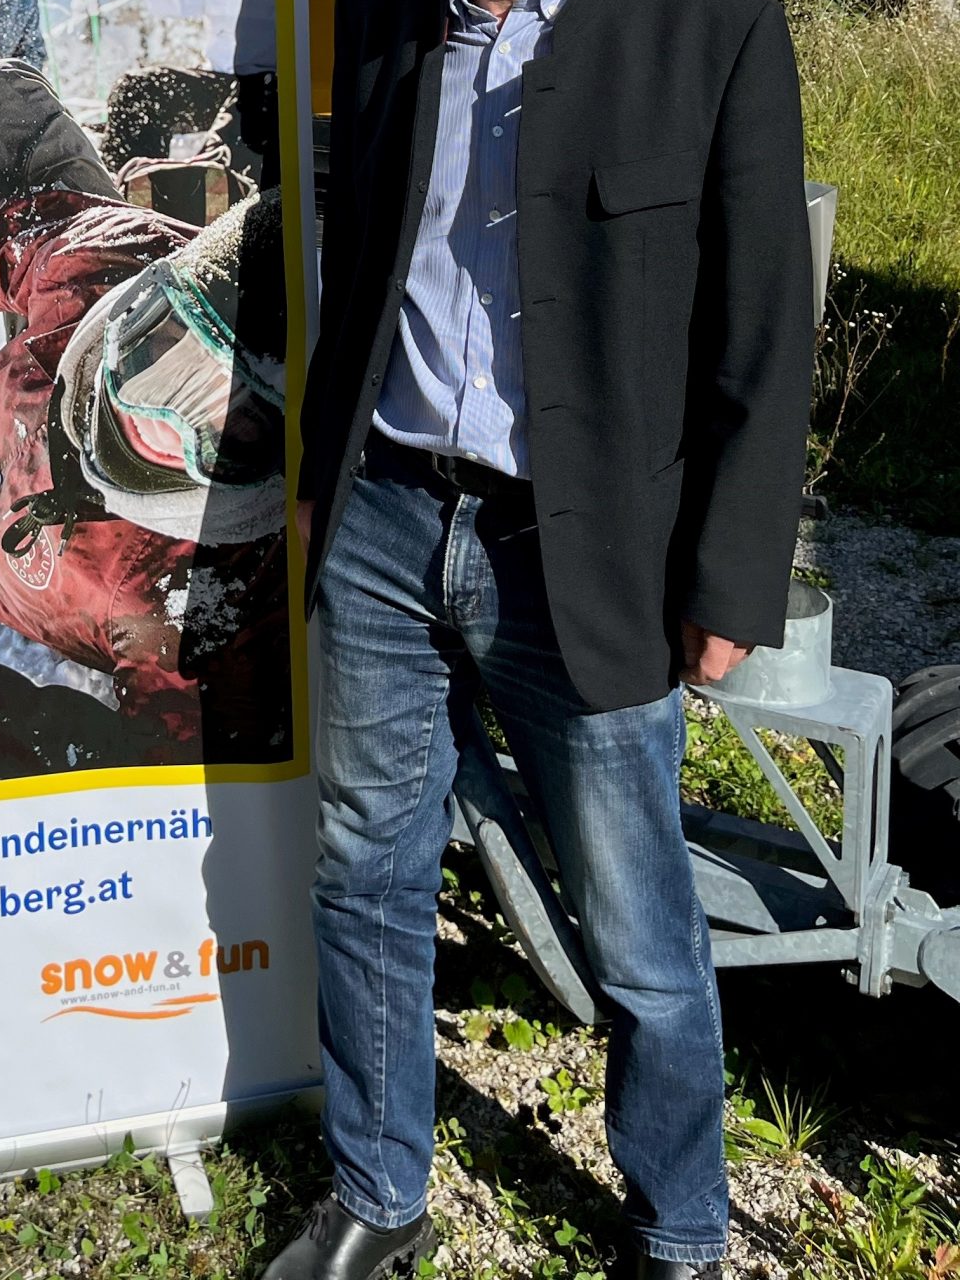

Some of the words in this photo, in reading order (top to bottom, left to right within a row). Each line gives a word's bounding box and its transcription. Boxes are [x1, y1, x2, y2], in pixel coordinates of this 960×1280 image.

[41, 951, 158, 996] snow
[163, 950, 191, 979] &
[198, 938, 270, 975] fun
[61, 982, 181, 1006] www.snow-and-fun.at
